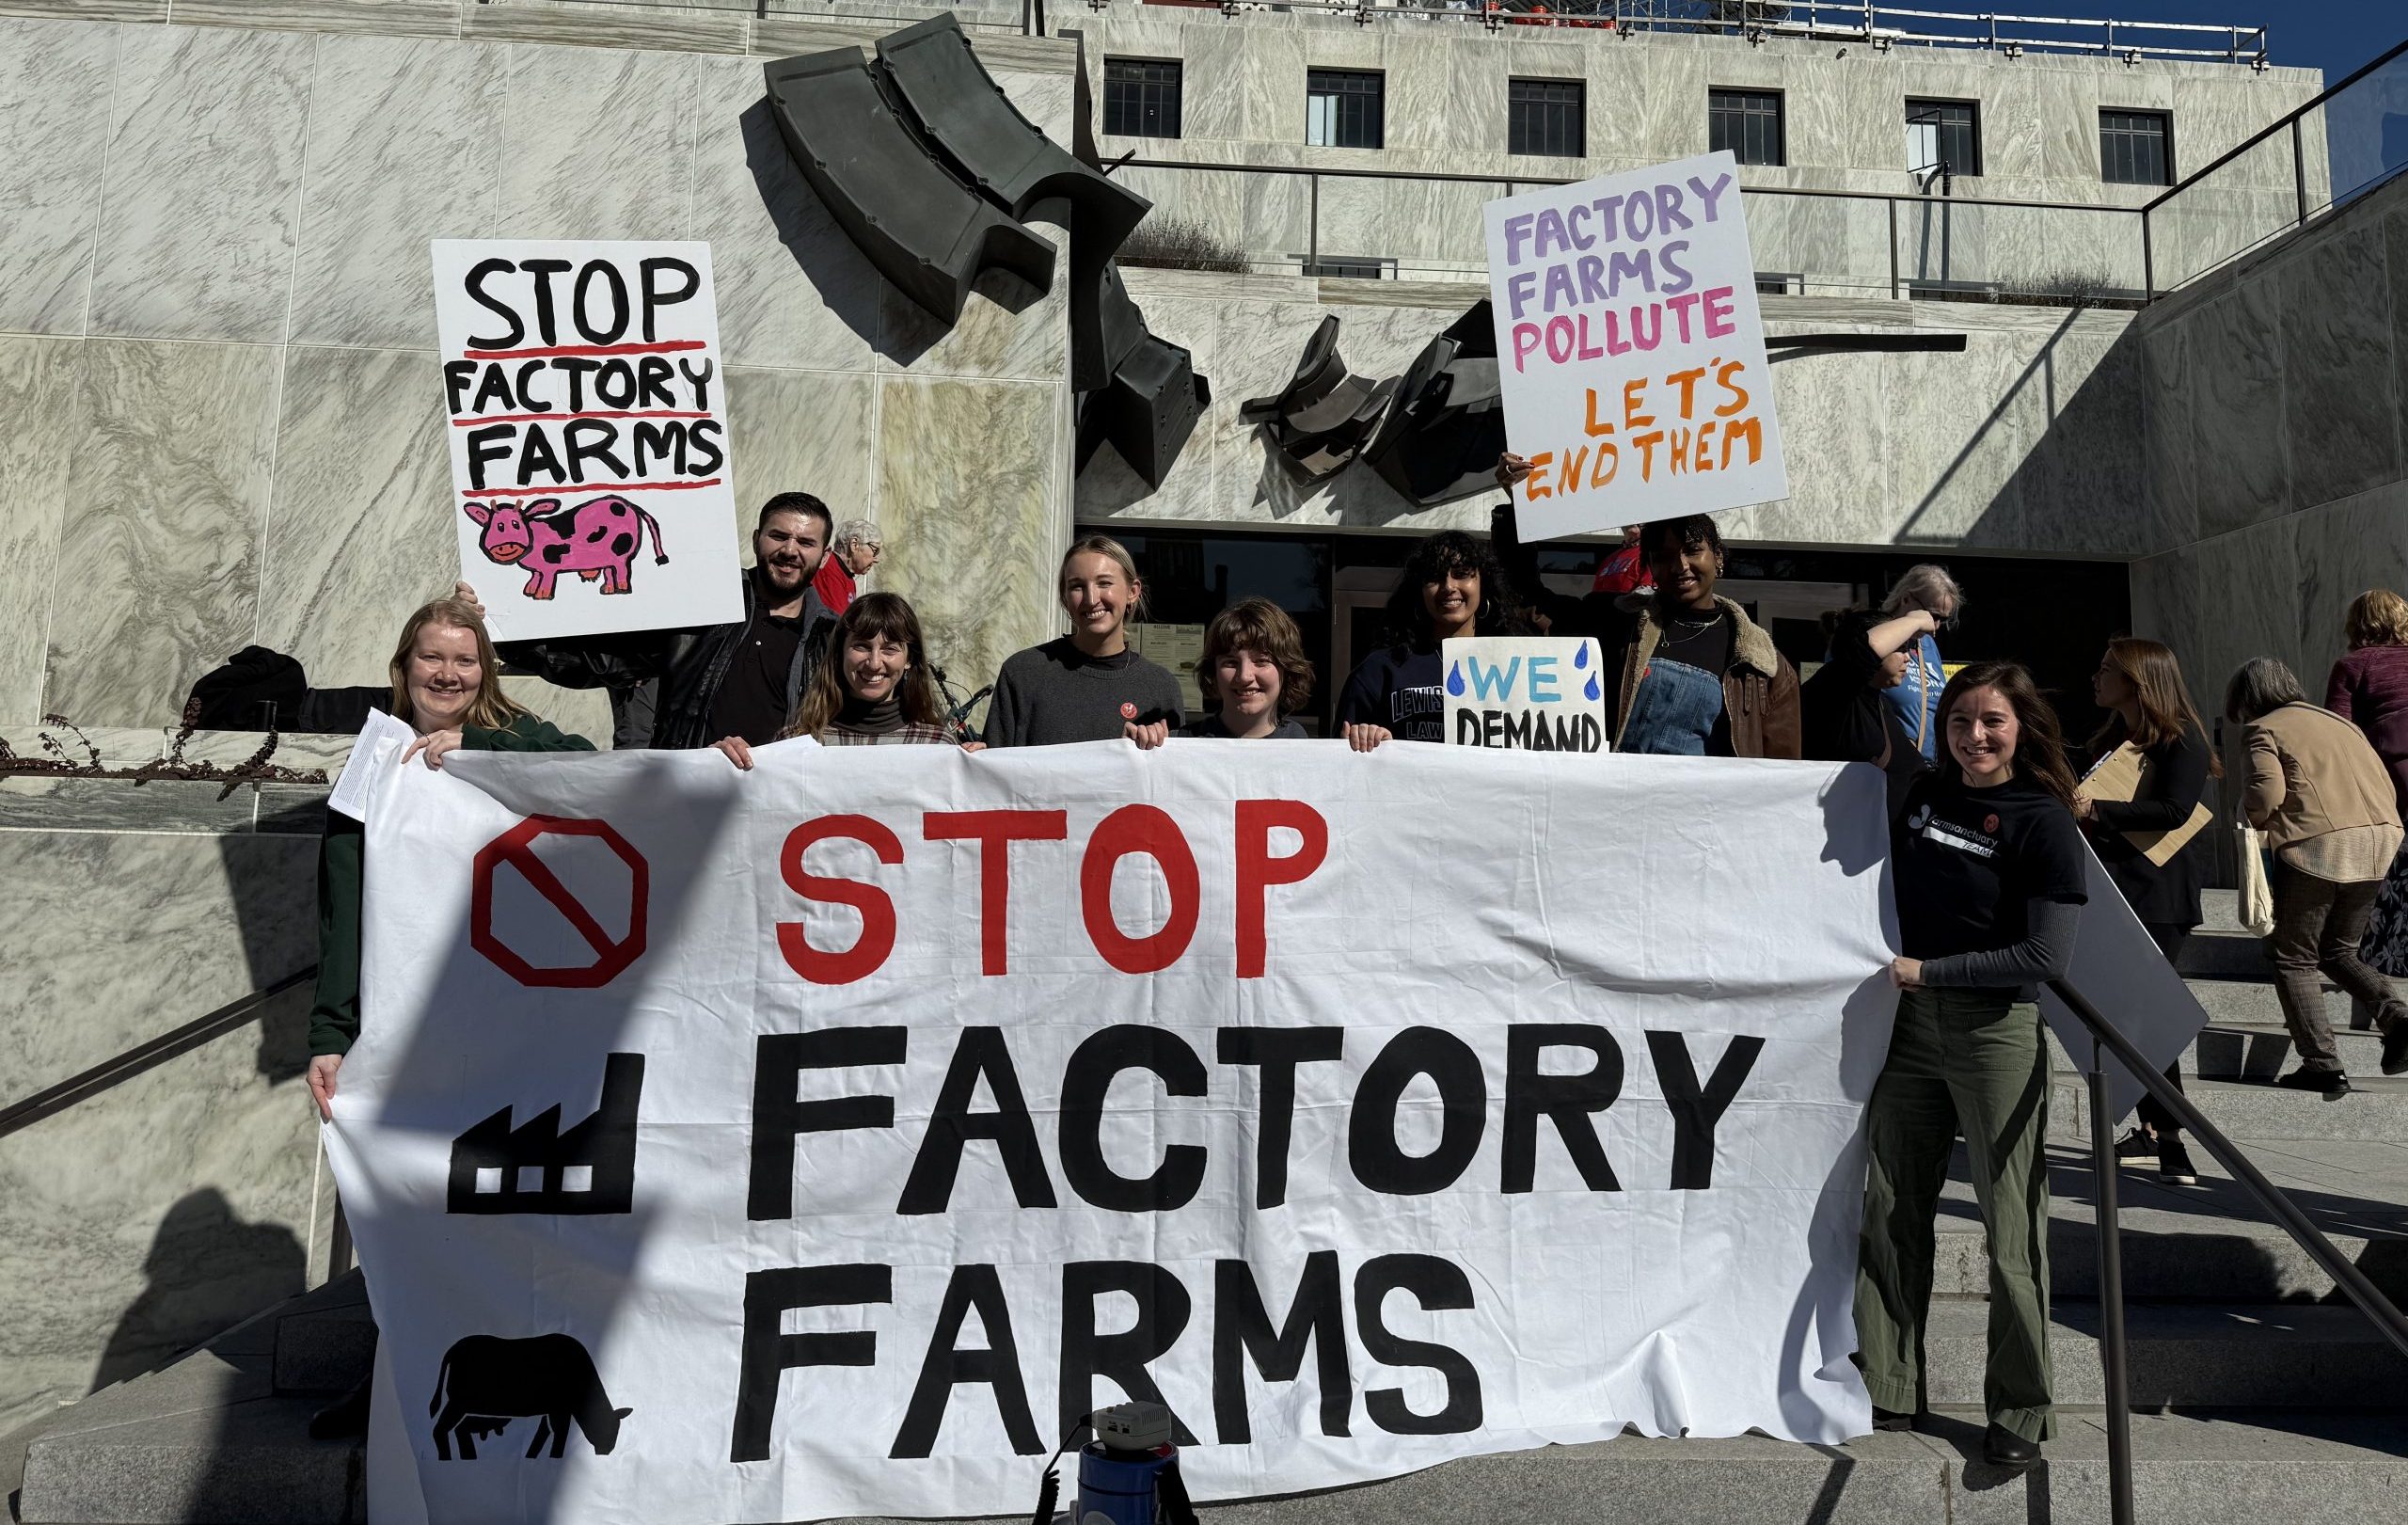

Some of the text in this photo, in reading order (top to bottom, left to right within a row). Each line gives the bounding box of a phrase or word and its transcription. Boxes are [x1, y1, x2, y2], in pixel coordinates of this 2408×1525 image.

[1504, 172, 1732, 266] FACTORY
[464, 257, 701, 350] STOP
[1507, 240, 1694, 320] FARMS
[1512, 285, 1735, 373] POLLUTE
[443, 357, 713, 415] FACTORY
[1584, 357, 1750, 437] LET'S
[467, 419, 723, 490] FARMS
[1526, 416, 1762, 502] END THEM
[1391, 686, 1444, 723] LEWIS
[1468, 656, 1562, 703] WE
[1406, 722, 1443, 739] LAW
[1456, 708, 1602, 753] DEMAND
[778, 800, 1327, 984] STOP
[747, 1024, 1766, 1221] FACTORY
[731, 1250, 1483, 1463] FARMS
